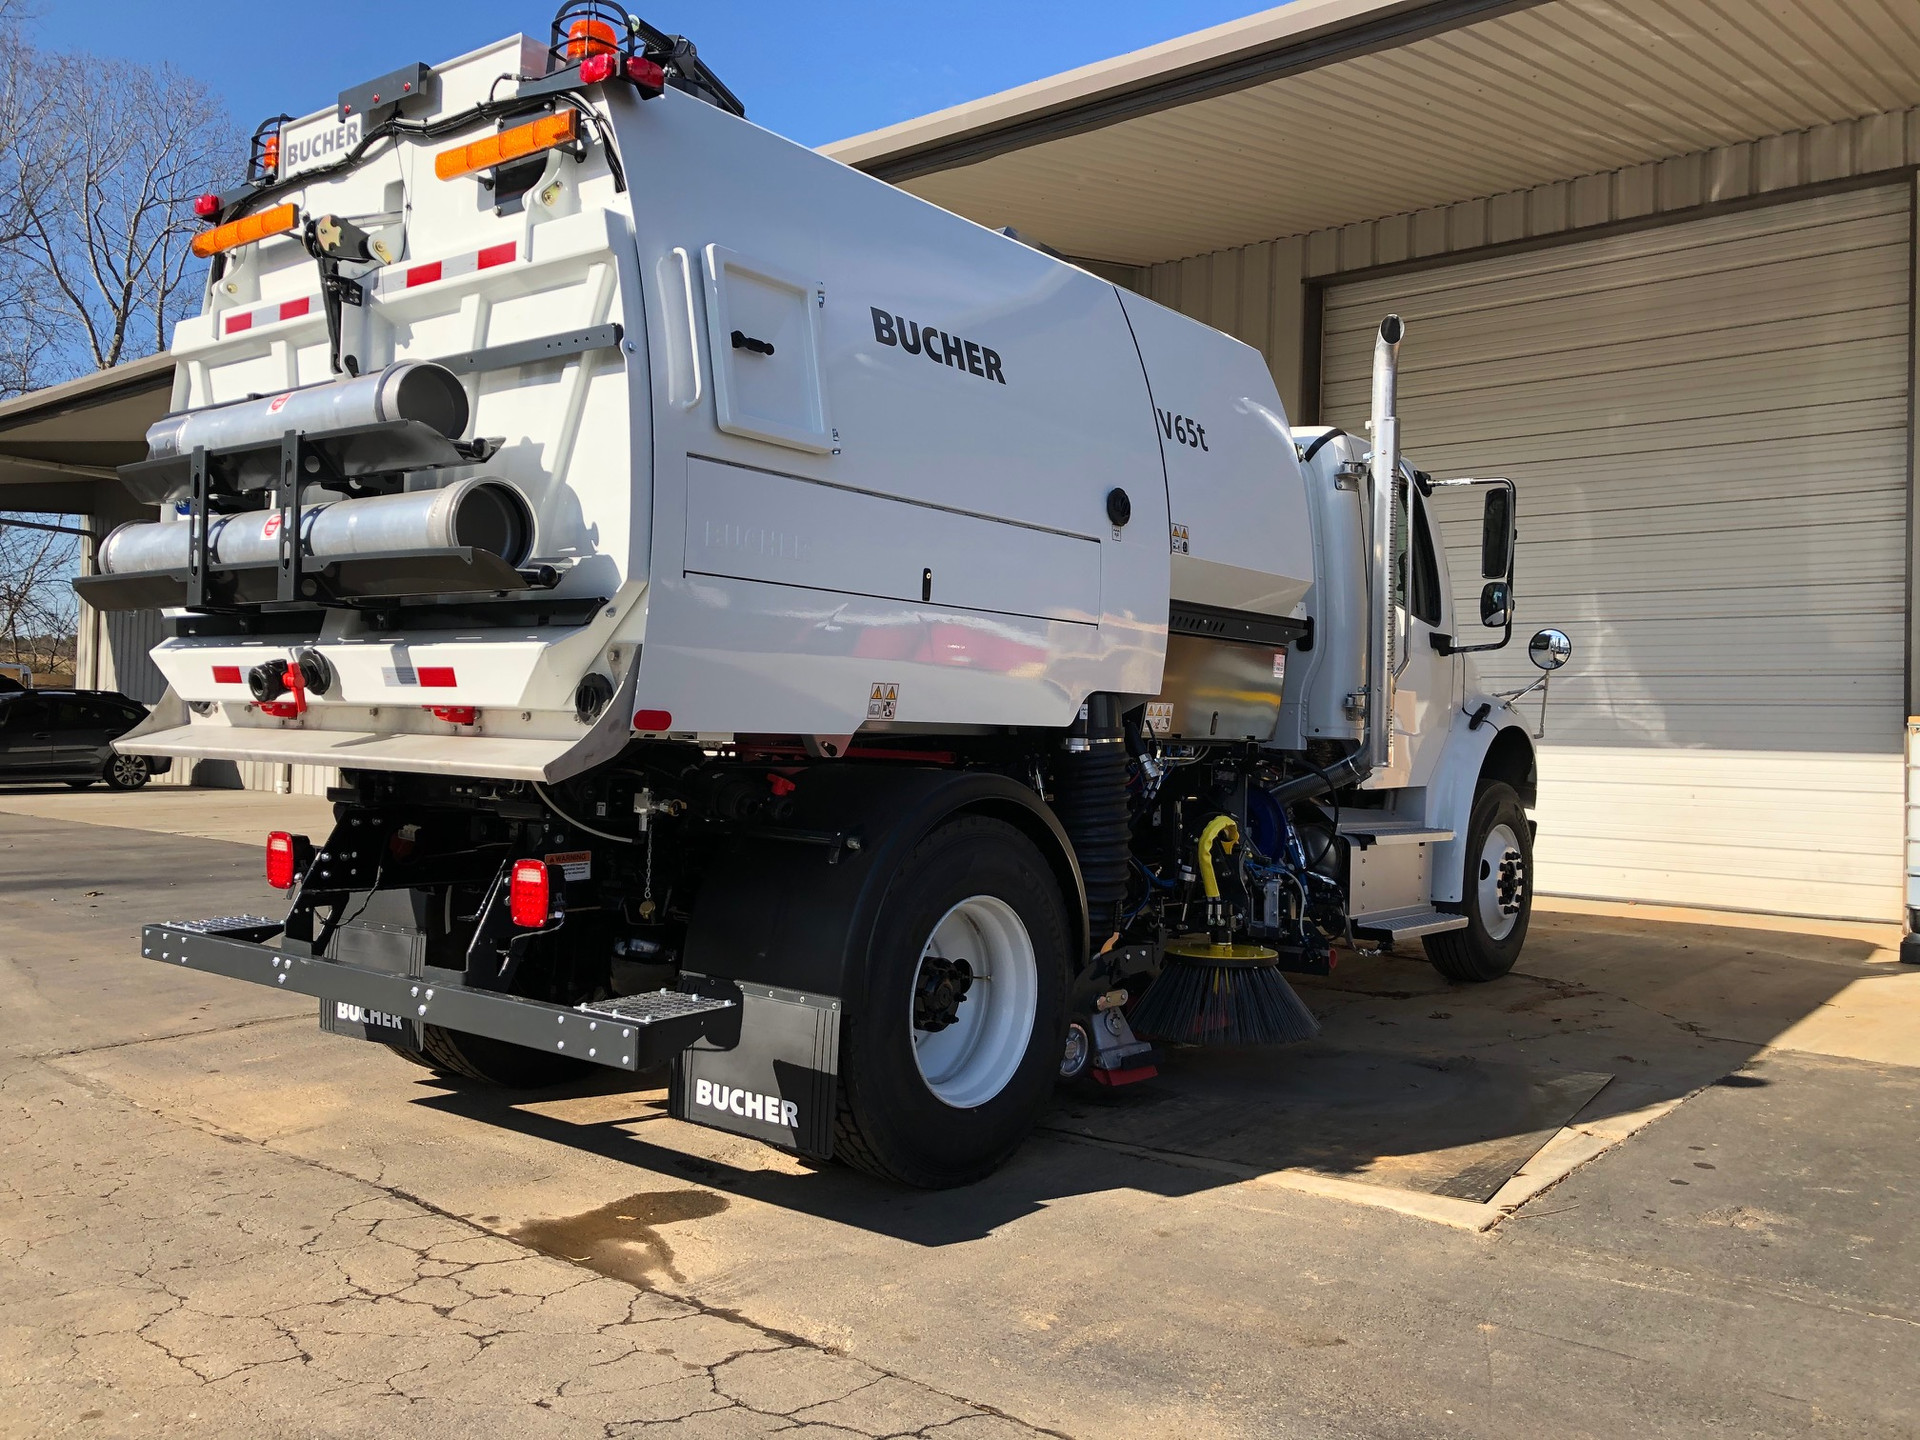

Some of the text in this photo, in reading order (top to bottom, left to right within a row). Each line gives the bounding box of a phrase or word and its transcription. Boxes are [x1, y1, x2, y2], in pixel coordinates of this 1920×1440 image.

[287, 122, 358, 167] BUCHER
[870, 306, 1006, 385] BUCHER
[1157, 407, 1209, 452] V65t
[337, 1001, 403, 1030] BUCHER
[696, 1078, 799, 1128] BUCHER
